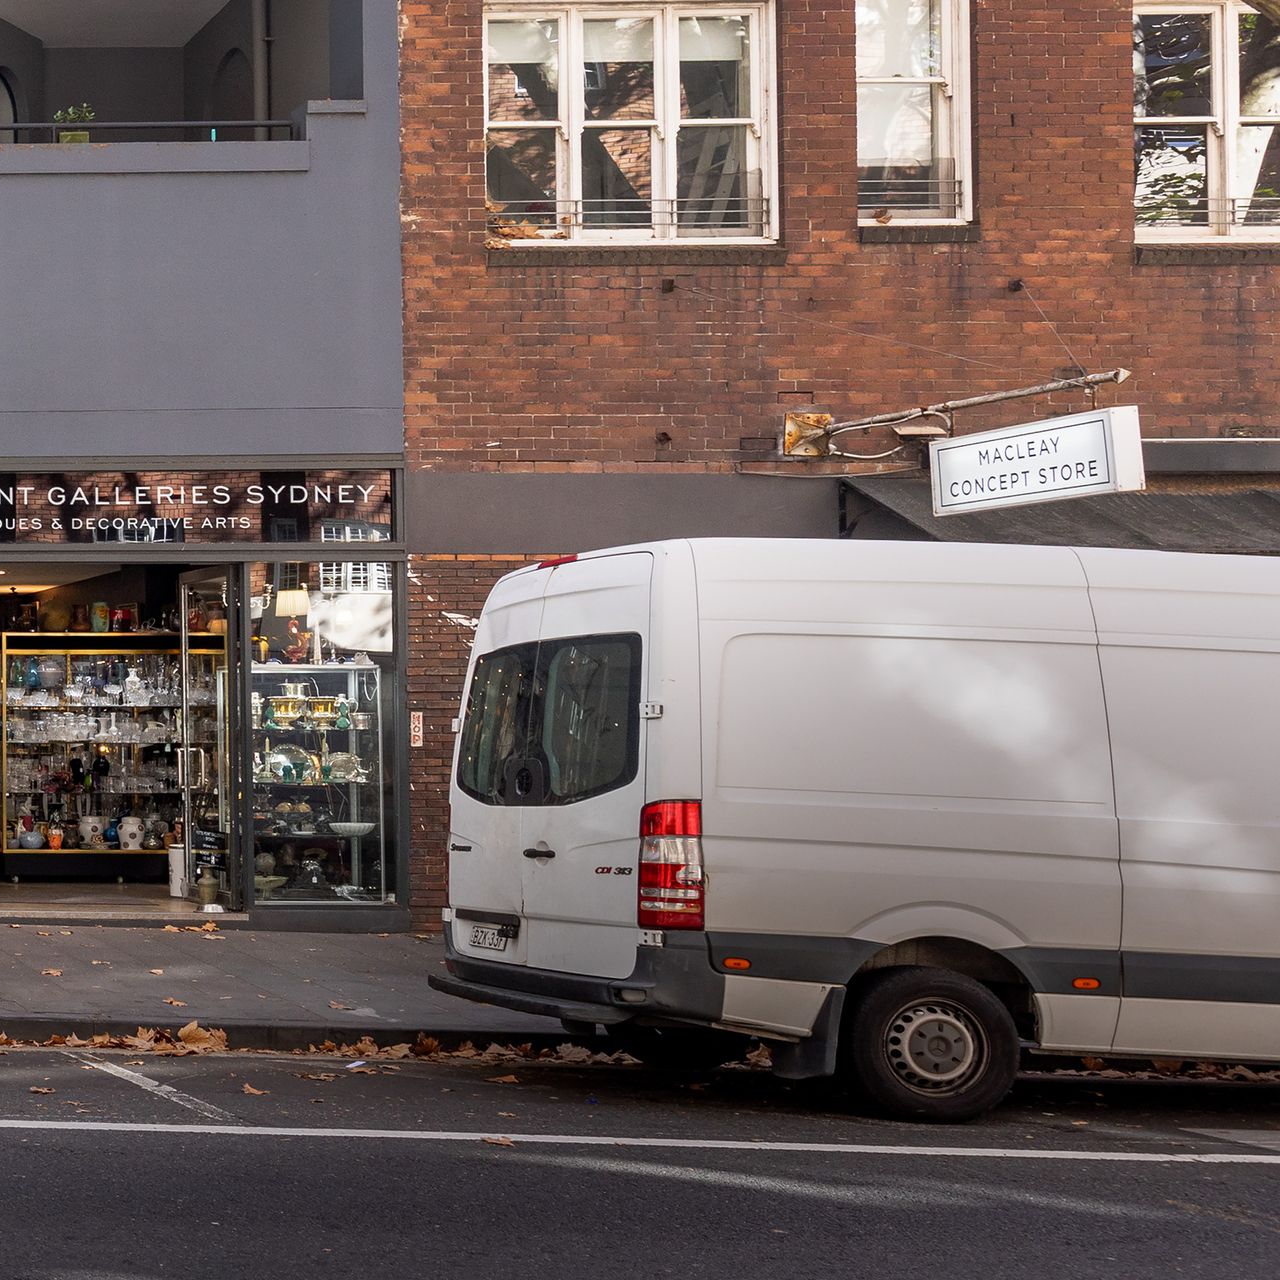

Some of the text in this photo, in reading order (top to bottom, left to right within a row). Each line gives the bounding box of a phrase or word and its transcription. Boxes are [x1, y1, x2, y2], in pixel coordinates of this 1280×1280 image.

[978, 436, 1060, 466] MACLEAY
[949, 459, 1099, 498] CONCEPT STORE
[47, 485, 232, 506] GALLERIES
[245, 484, 375, 505] SYDNEY
[51, 518, 64, 531] &
[71, 517, 194, 530] DECORATIVE
[201, 516, 251, 529] ARTS
